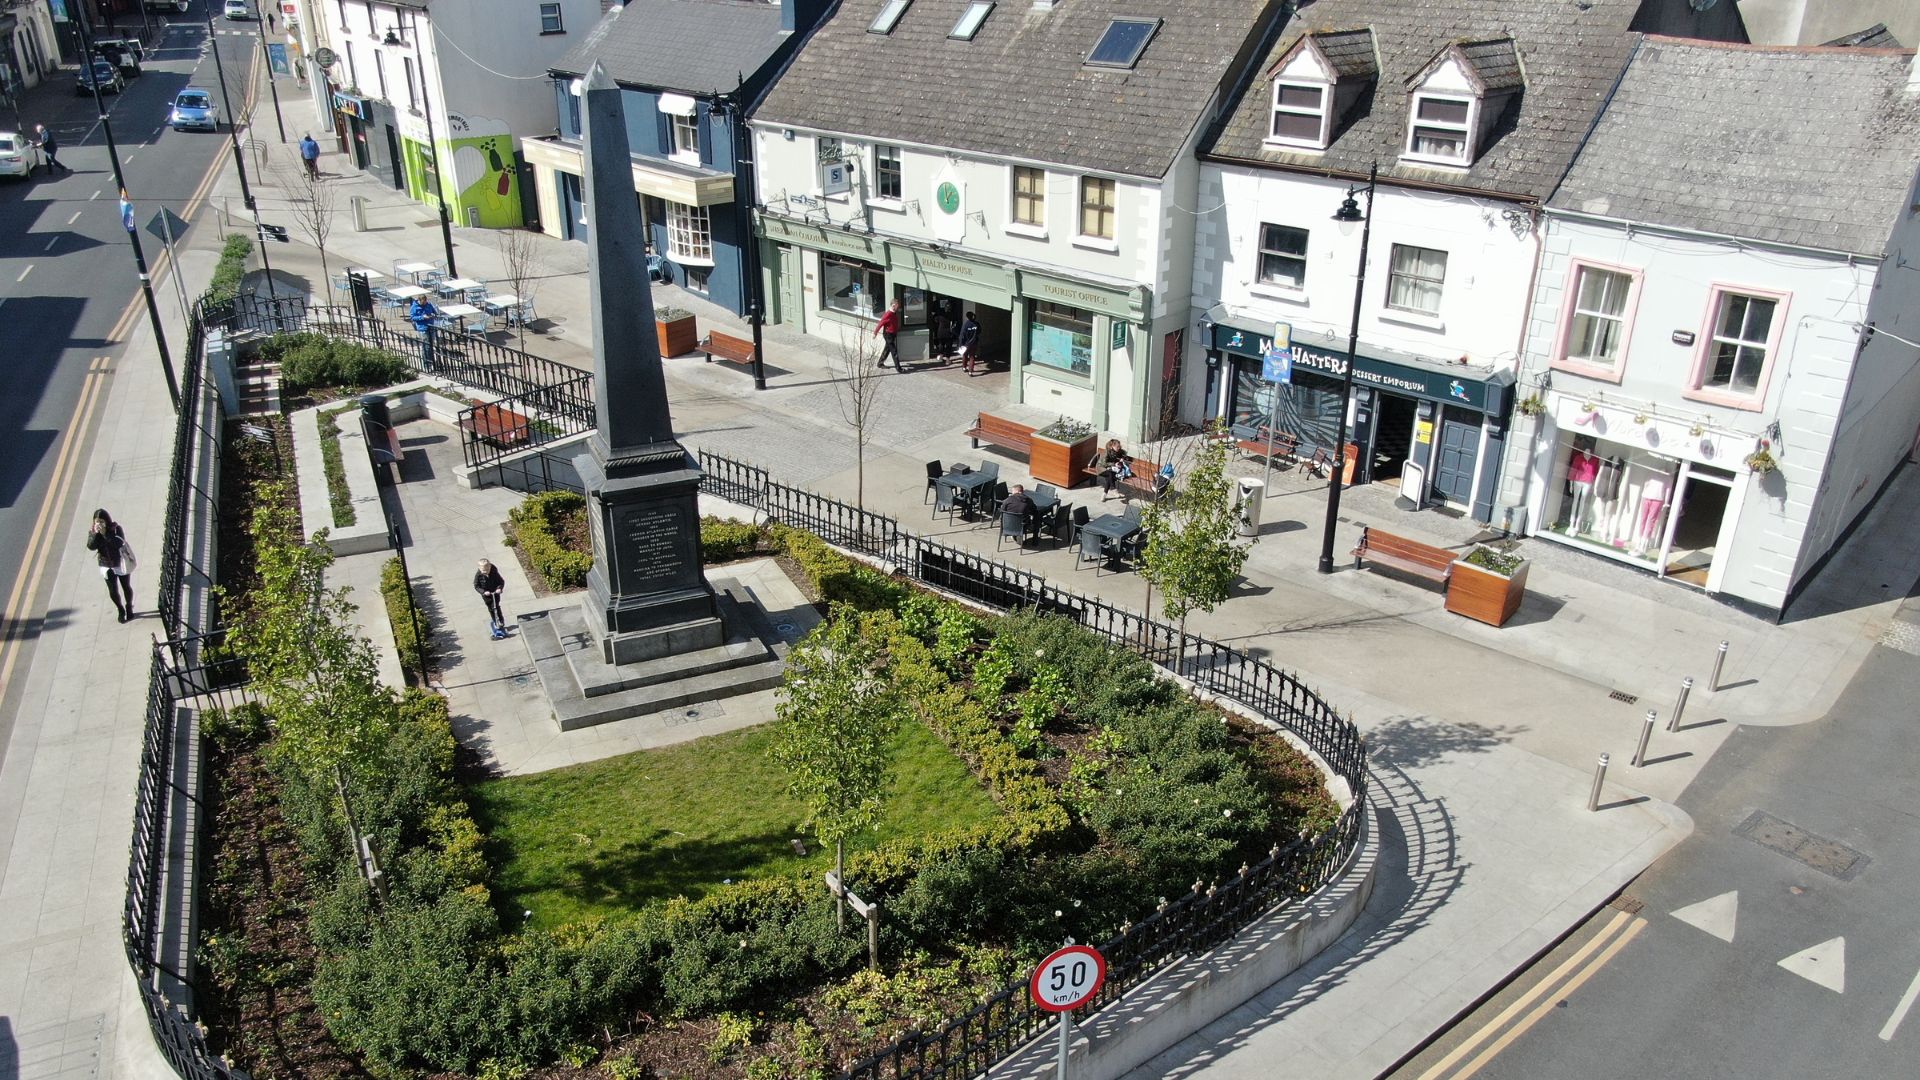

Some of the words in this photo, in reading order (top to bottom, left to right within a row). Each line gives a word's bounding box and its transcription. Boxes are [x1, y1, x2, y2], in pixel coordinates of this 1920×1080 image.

[948, 264, 973, 276] HOUSE
[1043, 284, 1078, 299] TOURIST
[1078, 291, 1109, 306] OFFICE
[1291, 346, 1348, 375] HATTERS
[1352, 368, 1381, 383] DESSERT
[1383, 376, 1425, 393] EMPORIUM
[1051, 961, 1087, 992] 50
[1053, 991, 1080, 1003] km/h
